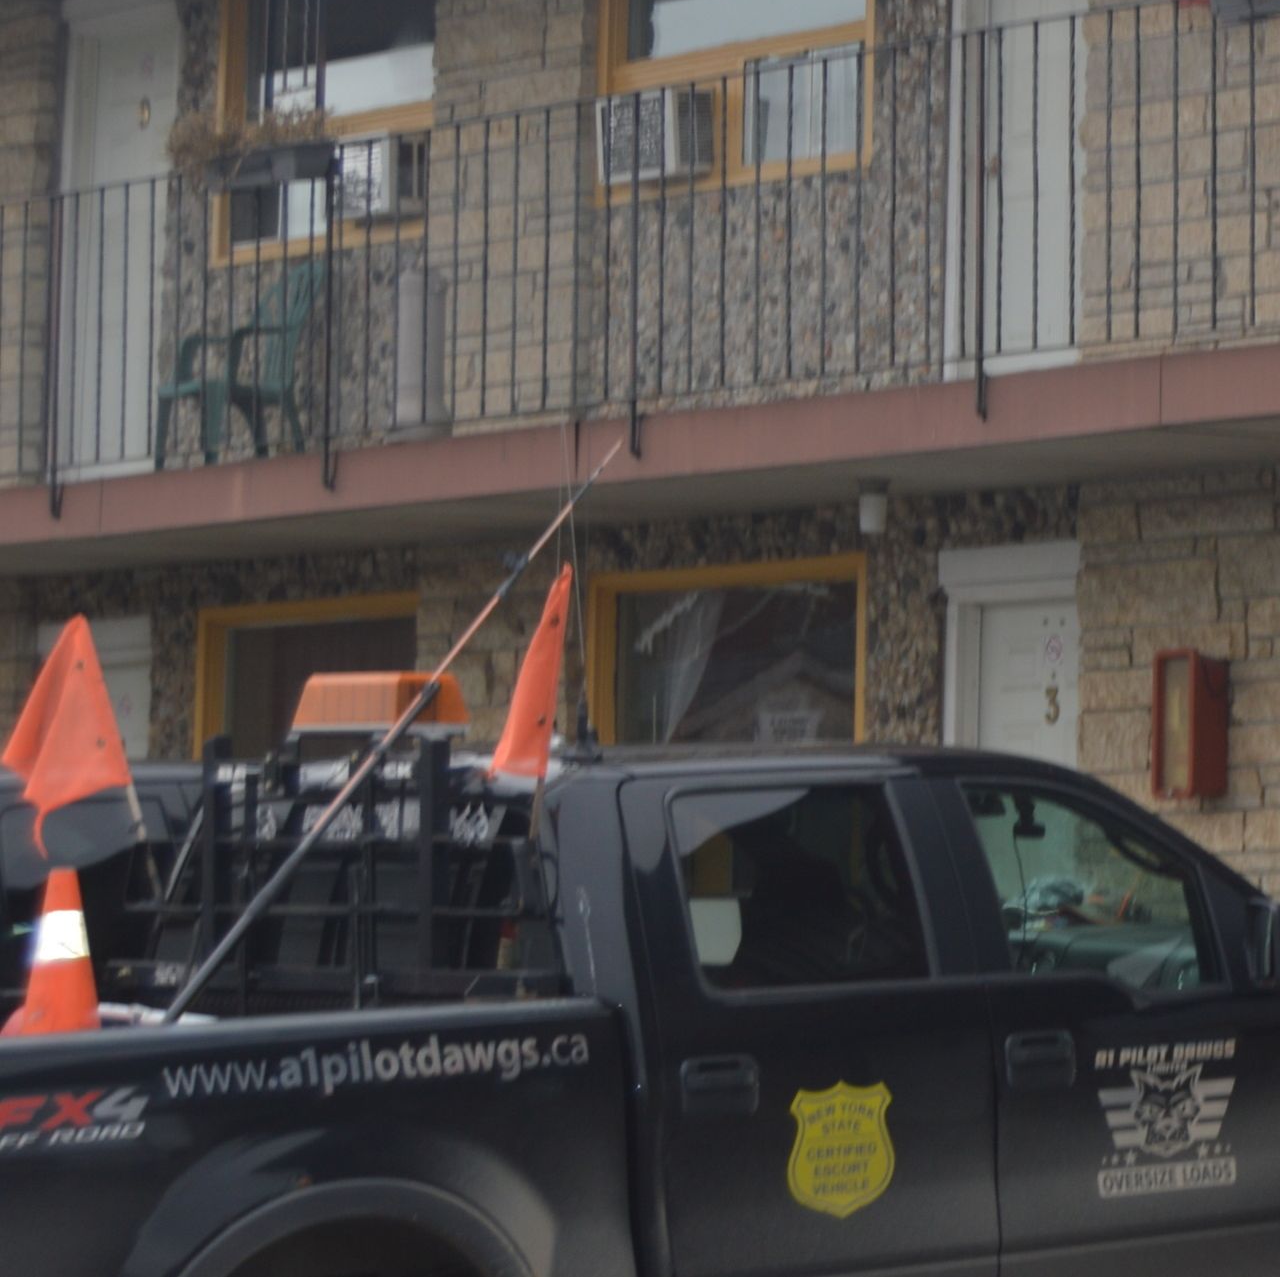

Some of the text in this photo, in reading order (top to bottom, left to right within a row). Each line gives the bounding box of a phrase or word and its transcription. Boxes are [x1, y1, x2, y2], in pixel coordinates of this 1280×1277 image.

[1045, 686, 1060, 726] 3
[163, 1032, 590, 1095] www.a1pilotdawgs.ca
[1119, 1044, 1169, 1068] PILOT
[0, 1086, 149, 1132] FX4
[841, 1100, 874, 1120] YORK
[0, 1121, 145, 1152] FF ROAD
[822, 1120, 861, 1135] STATE
[1103, 1163, 1232, 1190] OVERSIZE LOADS
